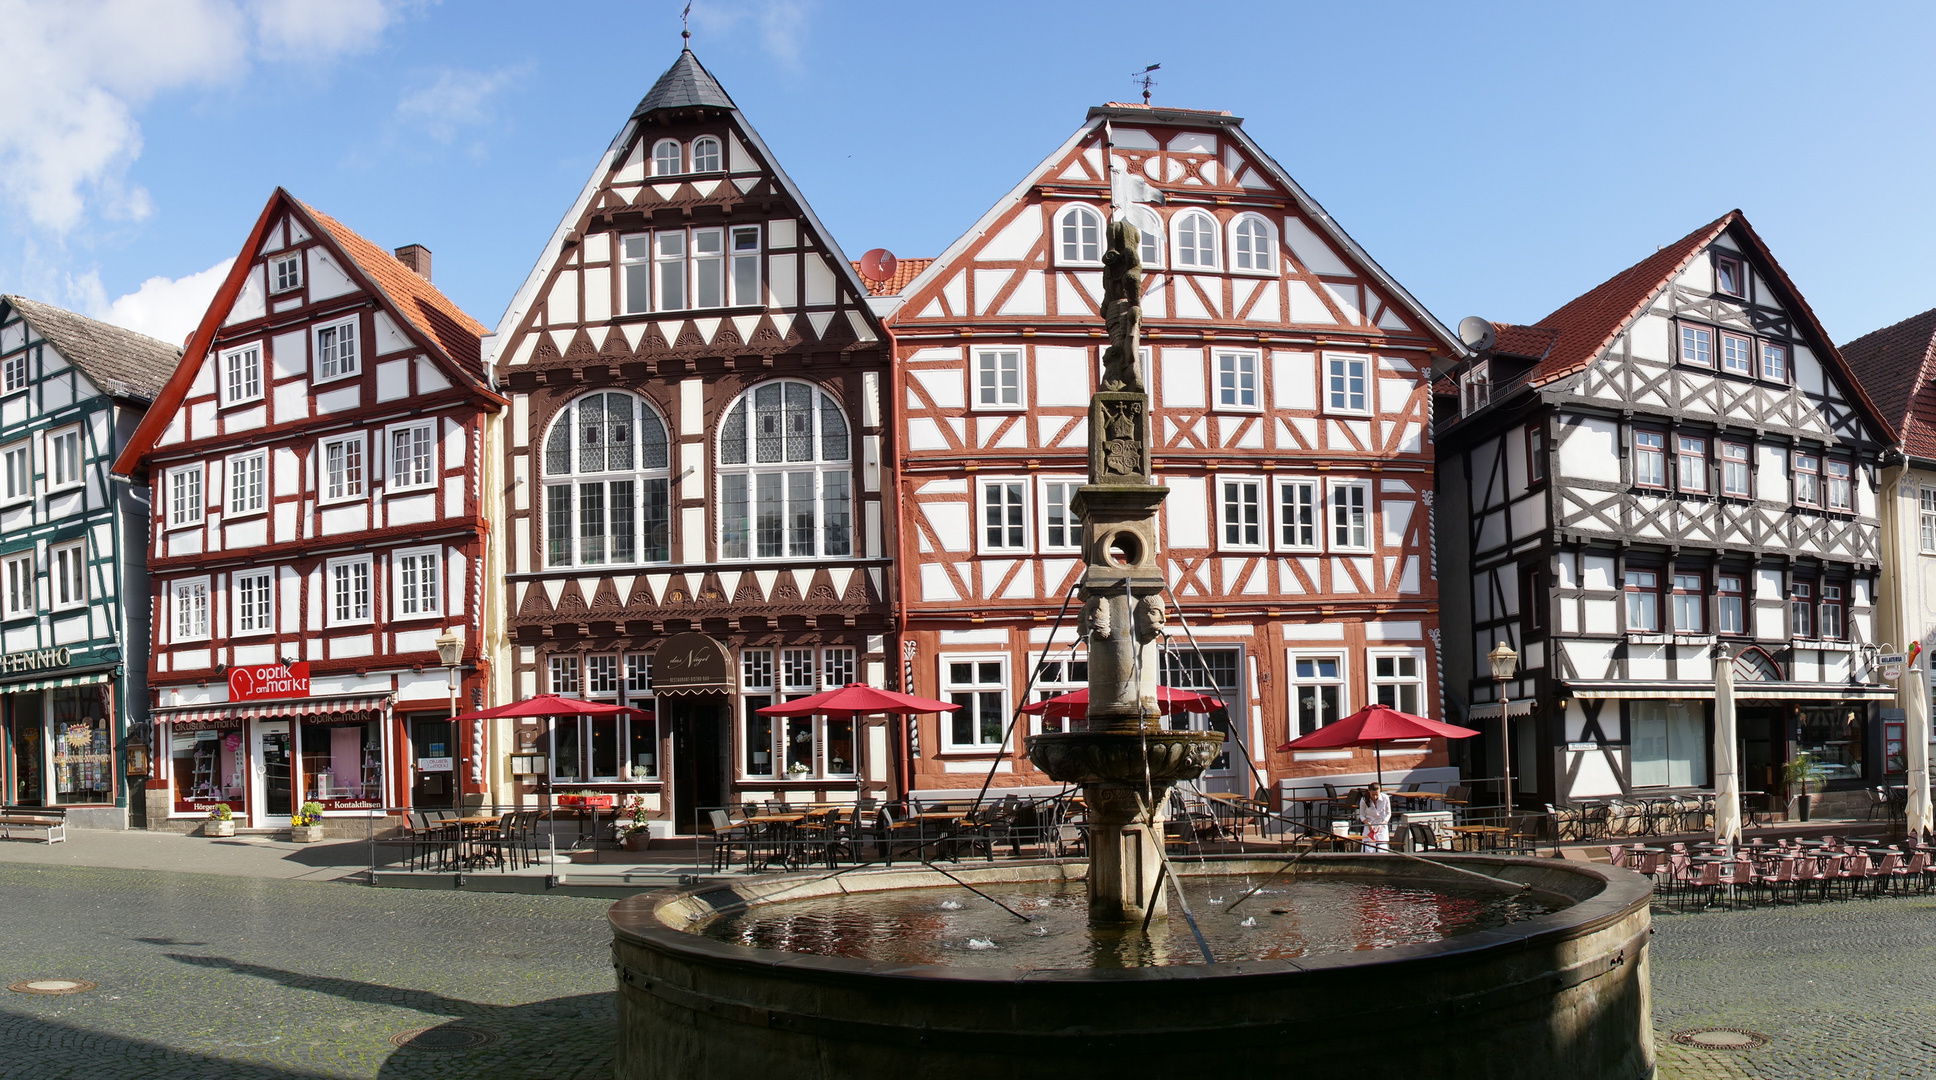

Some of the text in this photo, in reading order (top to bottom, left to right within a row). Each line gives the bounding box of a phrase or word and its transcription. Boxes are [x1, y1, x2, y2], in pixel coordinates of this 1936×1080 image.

[0, 647, 70, 673] FENNIG
[256, 665, 293, 681] optik
[266, 678, 308, 692] markt
[309, 713, 334, 724] optik
[341, 710, 371, 721] markt
[175, 720, 207, 731] akustik
[213, 719, 240, 729] markt
[334, 800, 382, 809] Kontaktlinsen
